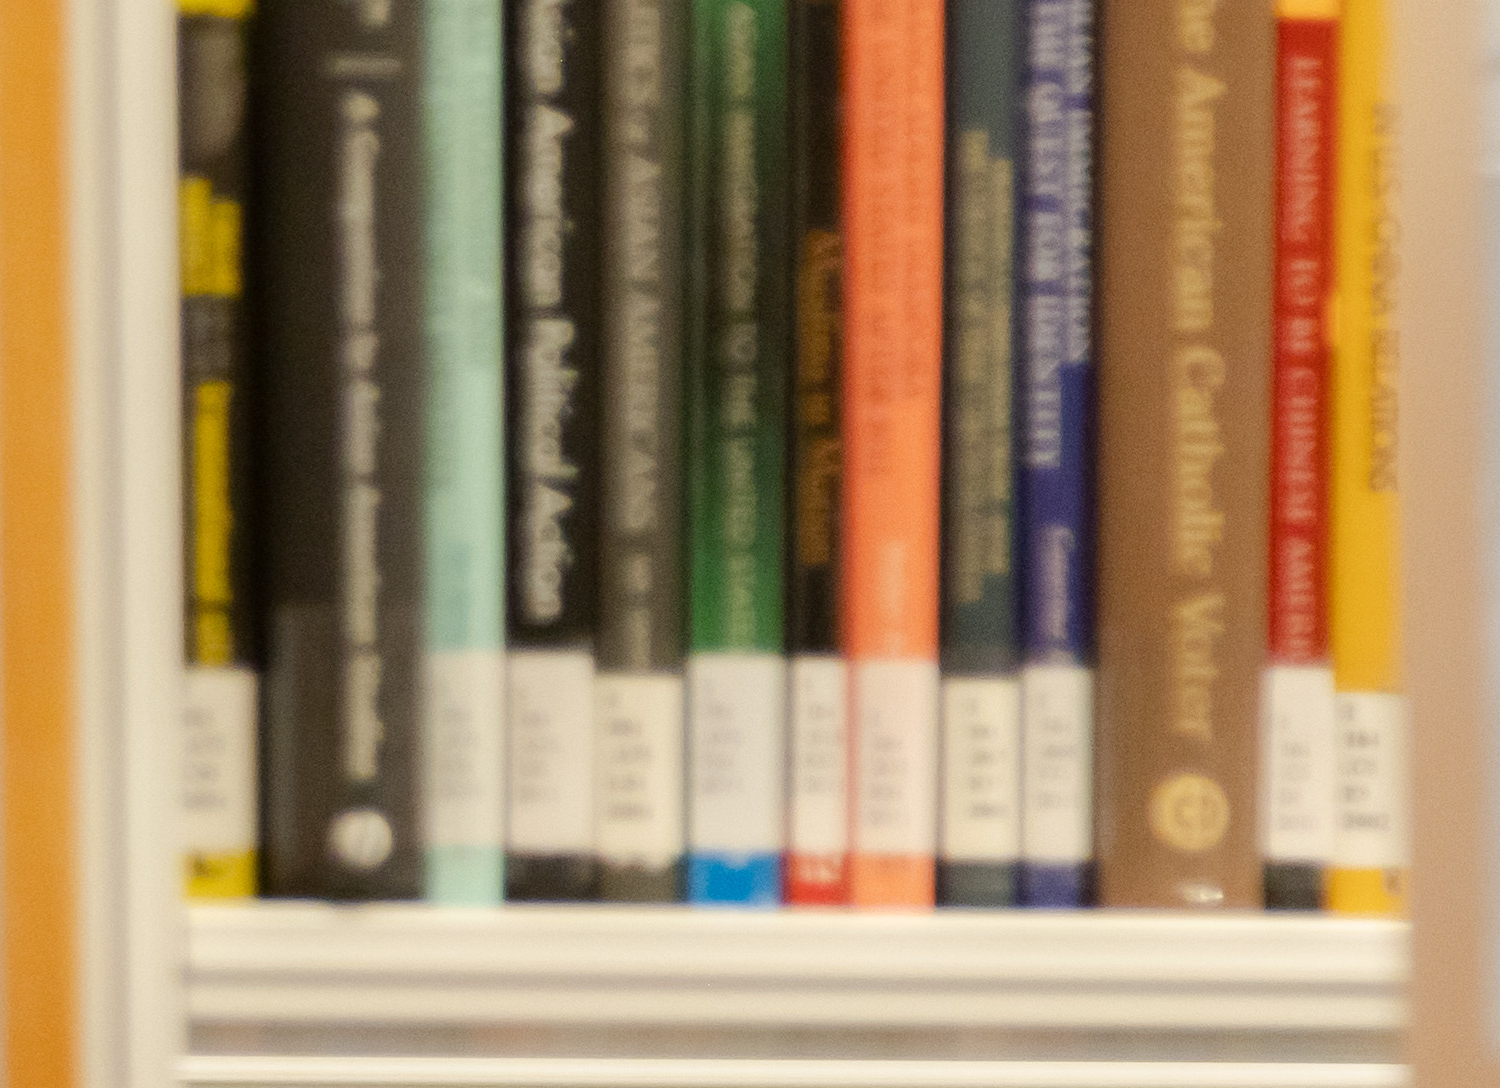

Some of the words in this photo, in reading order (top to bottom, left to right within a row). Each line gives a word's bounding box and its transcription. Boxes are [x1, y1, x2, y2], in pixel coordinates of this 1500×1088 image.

[530, 0, 576, 96] sian
[530, 105, 578, 307] American
[1171, 66, 1226, 331] American
[1283, 57, 1320, 242] LEARNING
[1283, 259, 1320, 304] TO
[530, 318, 578, 480] Political
[1171, 346, 1226, 576] Catholic
[530, 486, 578, 622] Action
[1171, 588, 1226, 744] Voter
